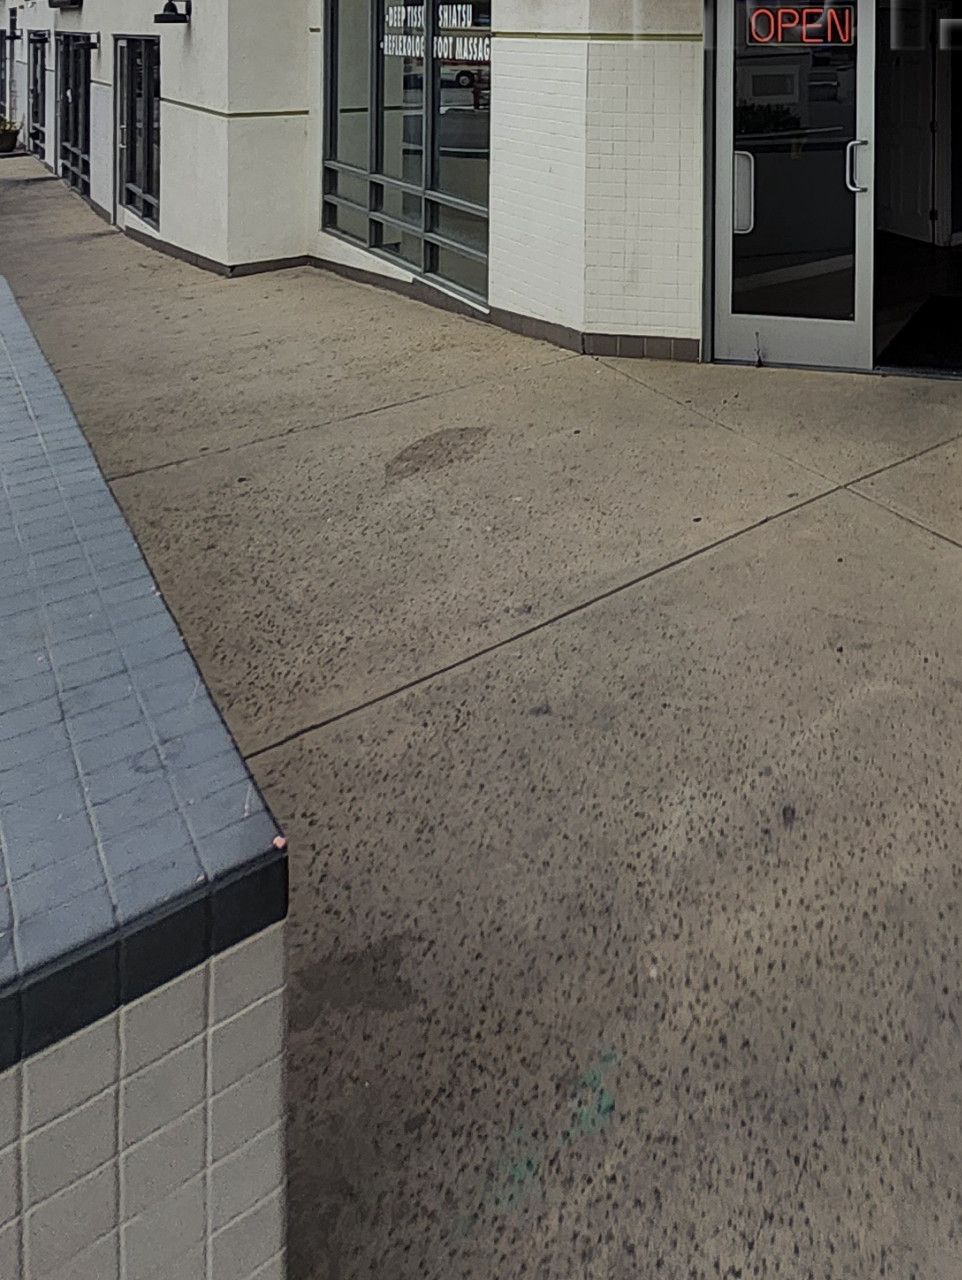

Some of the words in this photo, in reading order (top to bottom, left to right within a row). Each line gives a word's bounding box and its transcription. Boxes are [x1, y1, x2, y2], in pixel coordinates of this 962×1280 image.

[388, 6, 406, 27] DEEP
[438, 4, 472, 28] SHIATSU
[751, 8, 849, 42] OPEN
[384, 35, 425, 57] REFLEXOLOG
[433, 36, 453, 59] FOOT
[455, 37, 490, 61] MASSAG
